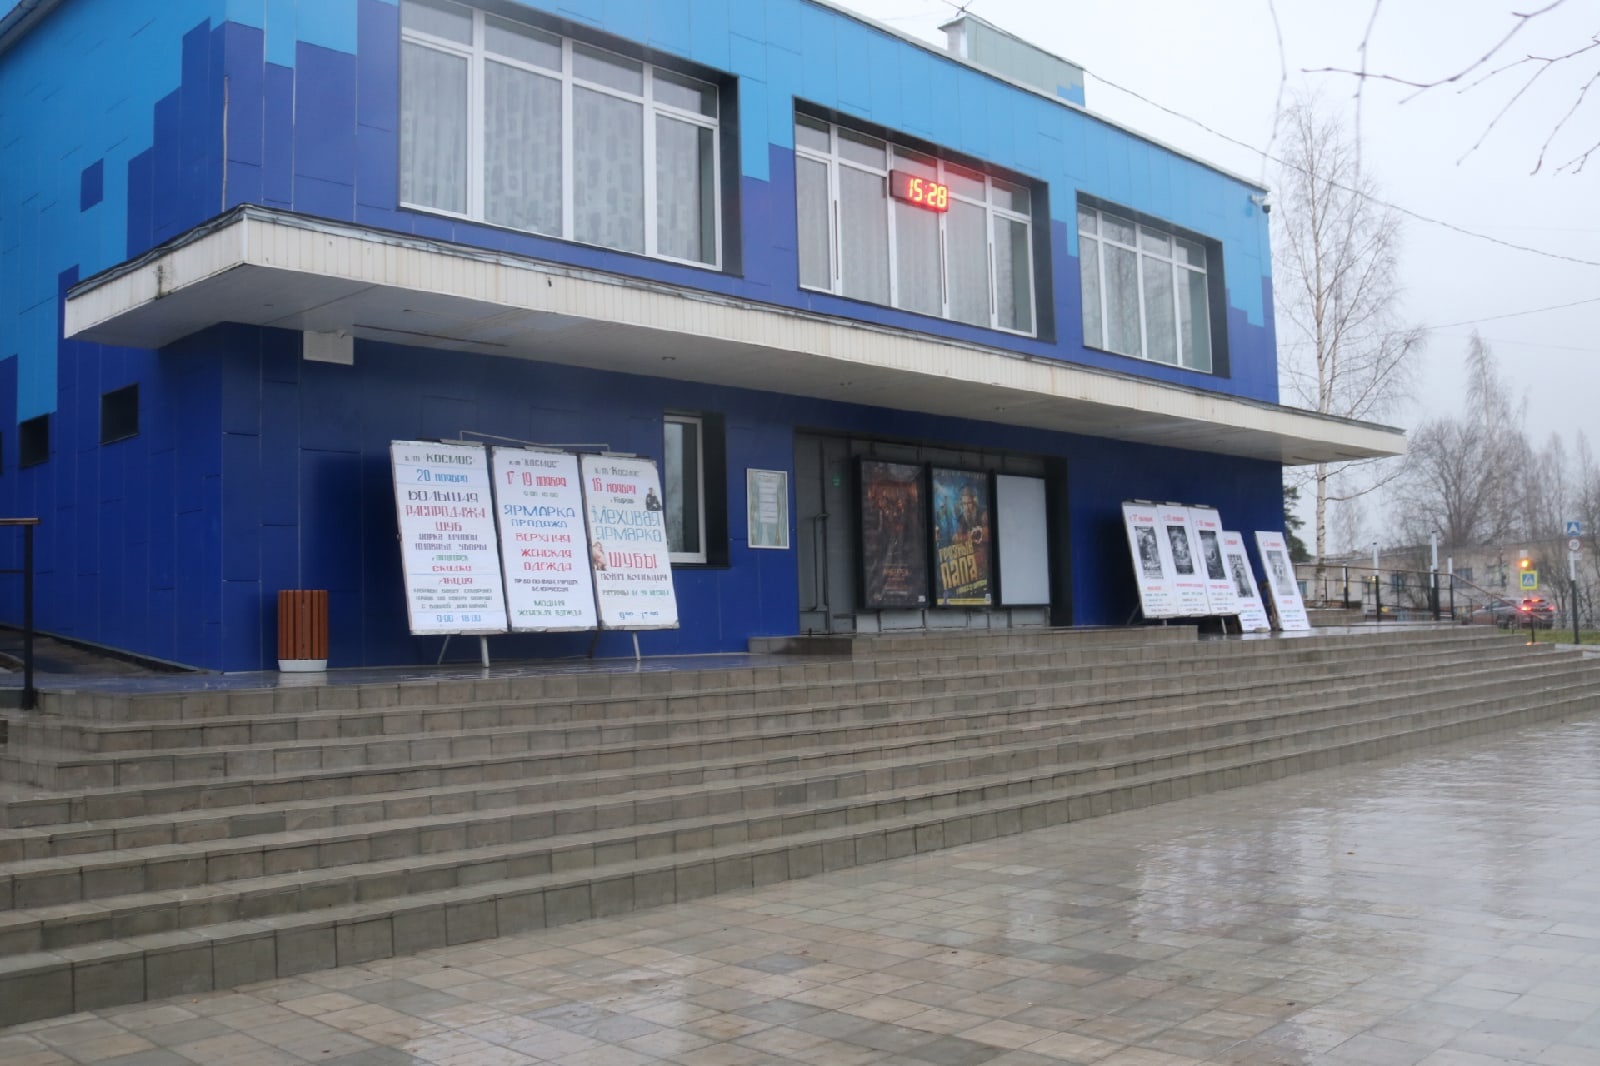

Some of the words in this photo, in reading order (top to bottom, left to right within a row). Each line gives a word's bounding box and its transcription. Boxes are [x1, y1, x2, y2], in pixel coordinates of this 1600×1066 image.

[909, 178, 948, 208] 15:28
[416, 469, 431, 482] 20
[592, 477, 602, 492] 16
[606, 483, 637, 495] ноября
[408, 490, 479, 503] БОЛЬШАЯ
[405, 505, 486, 518] РАСПРОДАЖА
[504, 504, 576, 518] ЯРМАРКА
[435, 521, 462, 532] ШУБ
[511, 518, 568, 529] ПРОДАЖА
[515, 532, 571, 543] ВЕРХНЯЯ
[520, 548, 572, 558] ЖЕНСКАЯ
[523, 561, 572, 571] ОДЕЖДА
[608, 551, 657, 569] ШУБЫ
